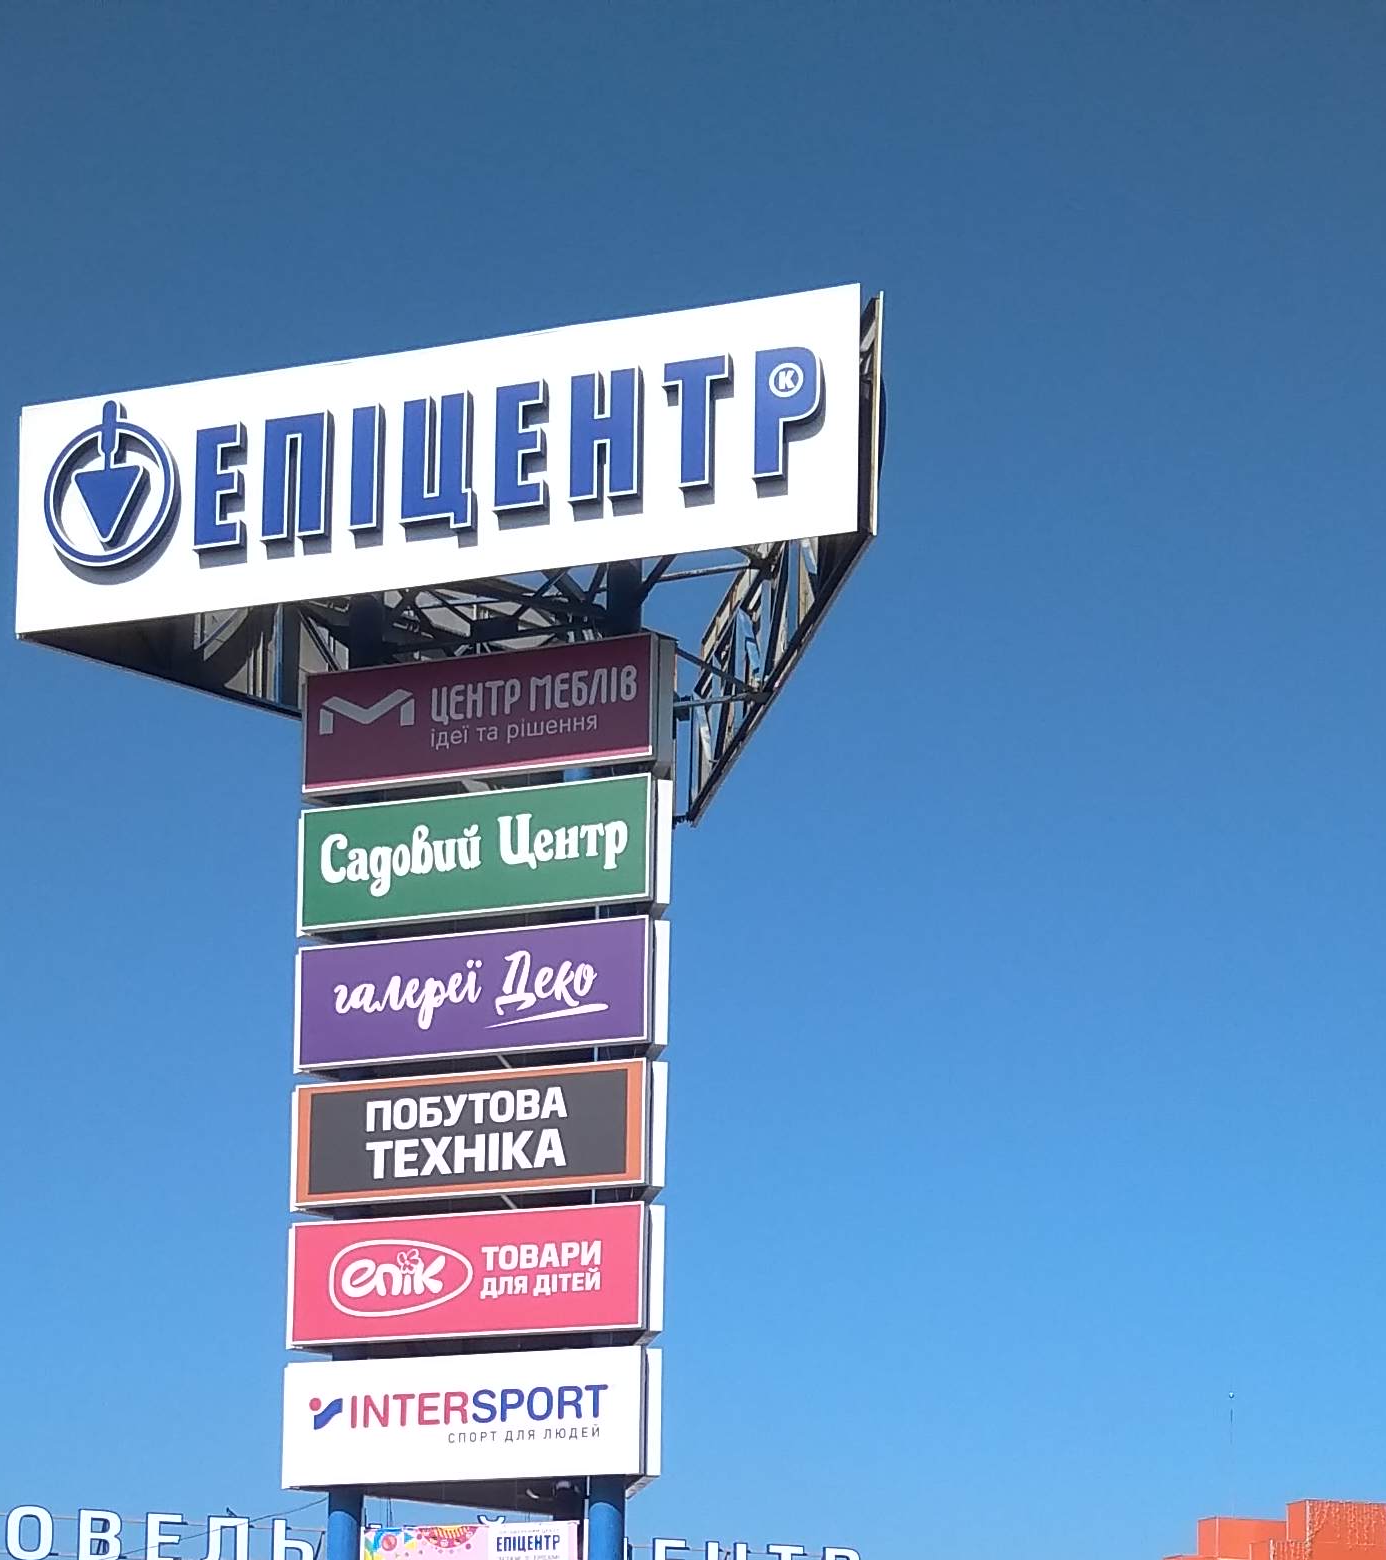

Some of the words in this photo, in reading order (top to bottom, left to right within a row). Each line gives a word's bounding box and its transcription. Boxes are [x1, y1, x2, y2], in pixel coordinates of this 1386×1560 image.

[193, 346, 823, 552] ЕПІЦЕНТР
[431, 678, 522, 724] ЦЕНТР
[528, 664, 639, 712] МЕБЛІВ
[430, 728, 469, 752] ідеї
[477, 726, 498, 743] та
[506, 712, 598, 742] рішення
[319, 823, 482, 898] Садовий
[496, 812, 629, 870] Центр
[332, 958, 483, 1031] галереї
[494, 949, 599, 1016] Деко
[365, 1086, 568, 1132] ПОБУТОВА
[365, 1128, 567, 1180] ТЕХНІКА
[481, 1240, 603, 1272] ТОВАРИ
[479, 1275, 527, 1300] ДЛЯ
[532, 1268, 602, 1297] ДІТЕЙ
[349, 1383, 609, 1430] INTERSPORT
[447, 1430, 497, 1445] СПОРТ
[504, 1428, 536, 1443] ДЛЯ
[543, 1424, 601, 1441] ЛЮДЕЙ
[496, 1534, 561, 1552] ЕПІЦЕНТР
